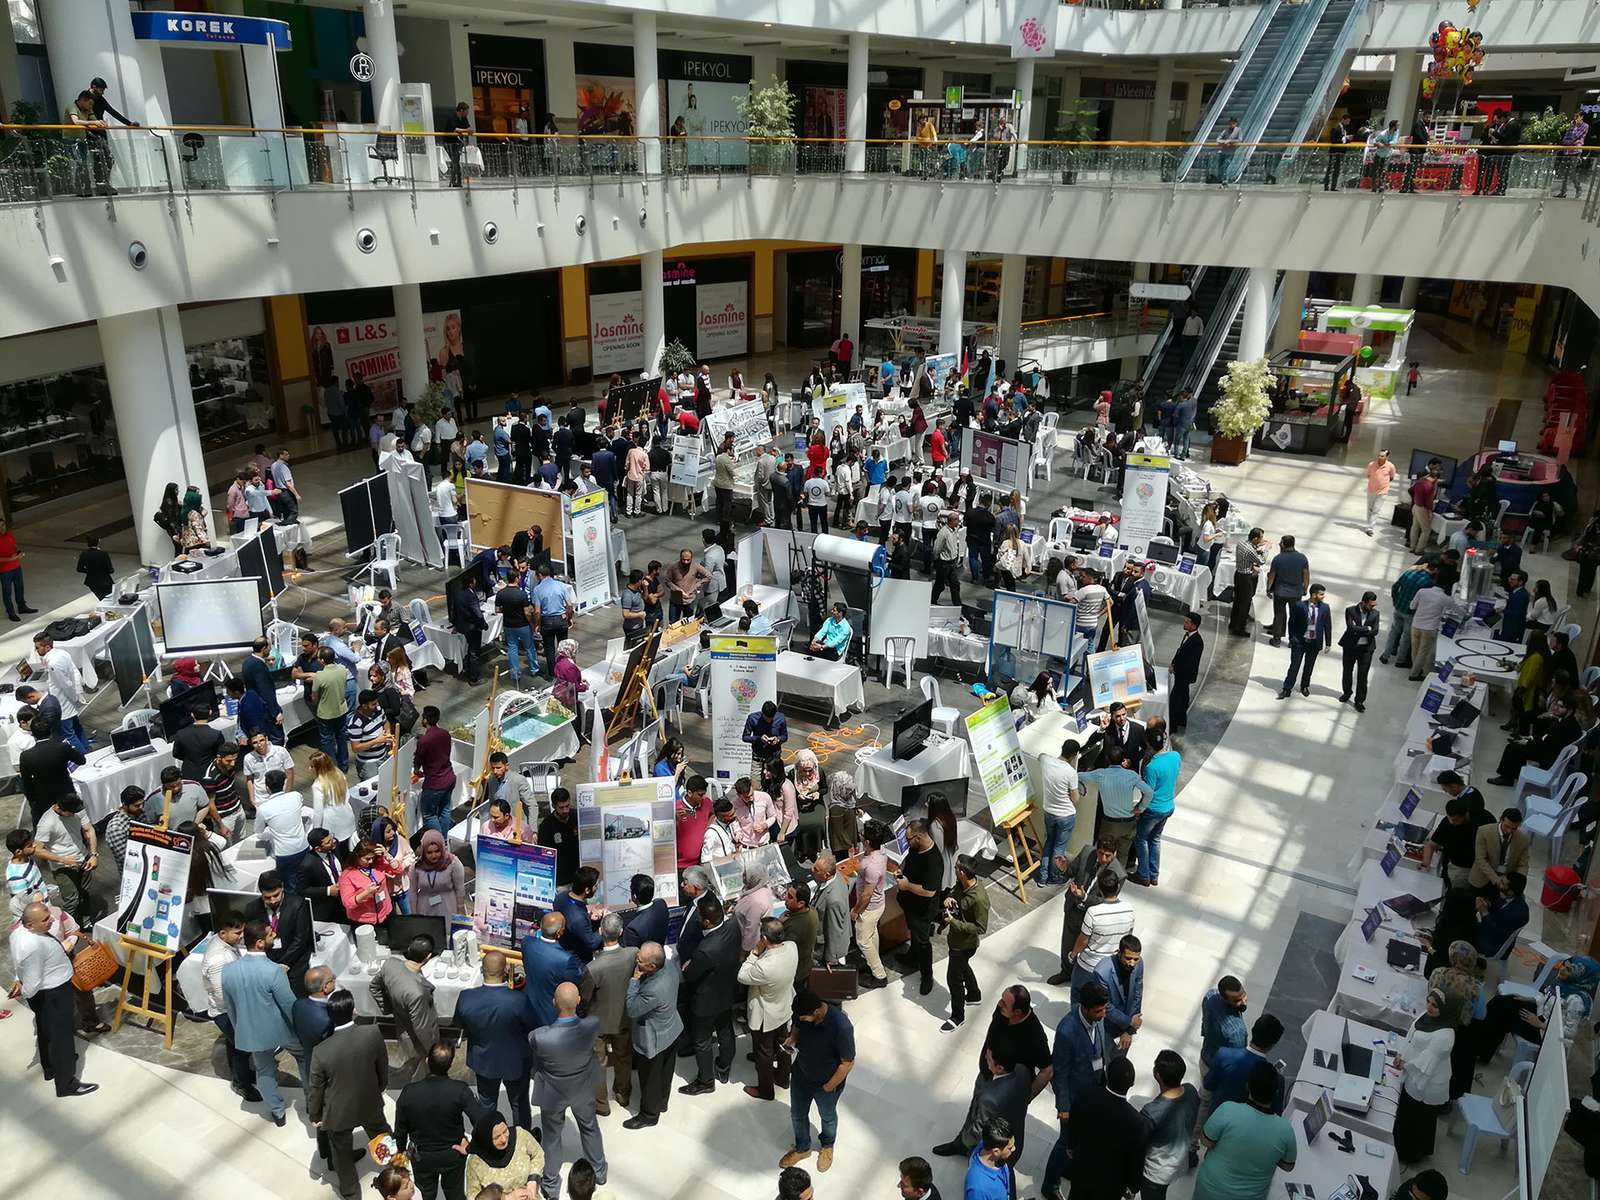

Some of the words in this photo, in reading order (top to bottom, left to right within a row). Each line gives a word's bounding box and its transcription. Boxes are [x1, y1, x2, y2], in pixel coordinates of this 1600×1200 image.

[167, 19, 235, 33] KOREK
[476, 70, 525, 86] IPEKYOL
[683, 60, 732, 79] IPEKYOL
[698, 309, 745, 326] Jasmine
[355, 324, 388, 342] L&S
[602, 343, 626, 352] OPENING
[351, 352, 397, 377] COMING
